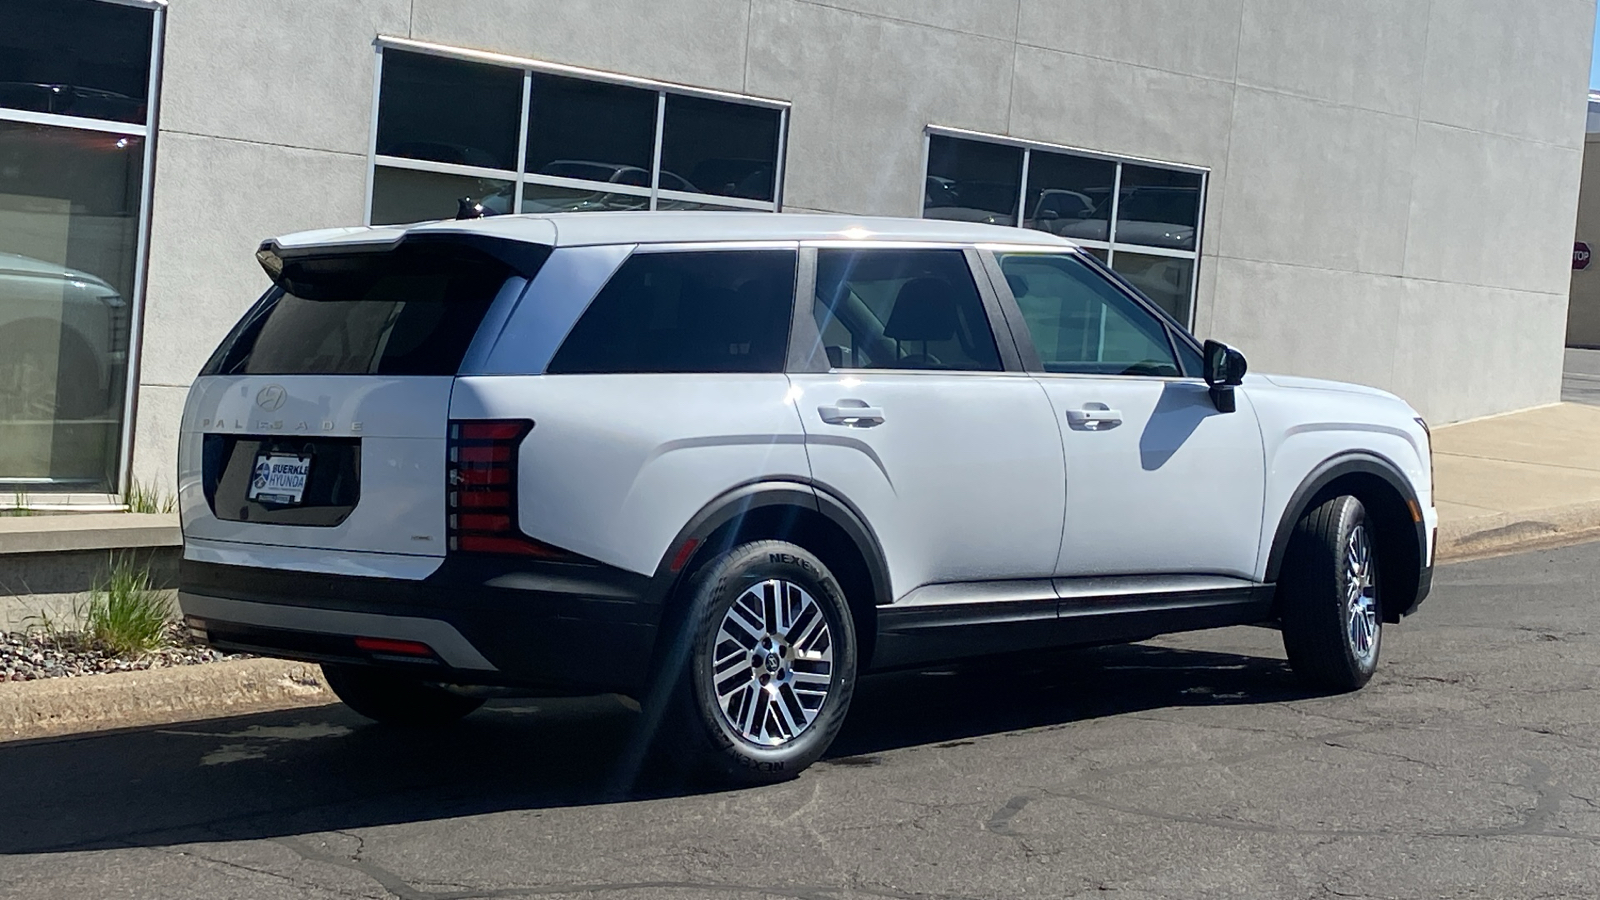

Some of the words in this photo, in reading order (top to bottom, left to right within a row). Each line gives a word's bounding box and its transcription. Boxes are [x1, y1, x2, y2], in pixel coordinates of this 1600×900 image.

[1574, 251, 1590, 261] TOP
[203, 418, 363, 432] PALISADE
[272, 464, 309, 475] BUERKLE
[268, 474, 304, 488] HYUNDA
